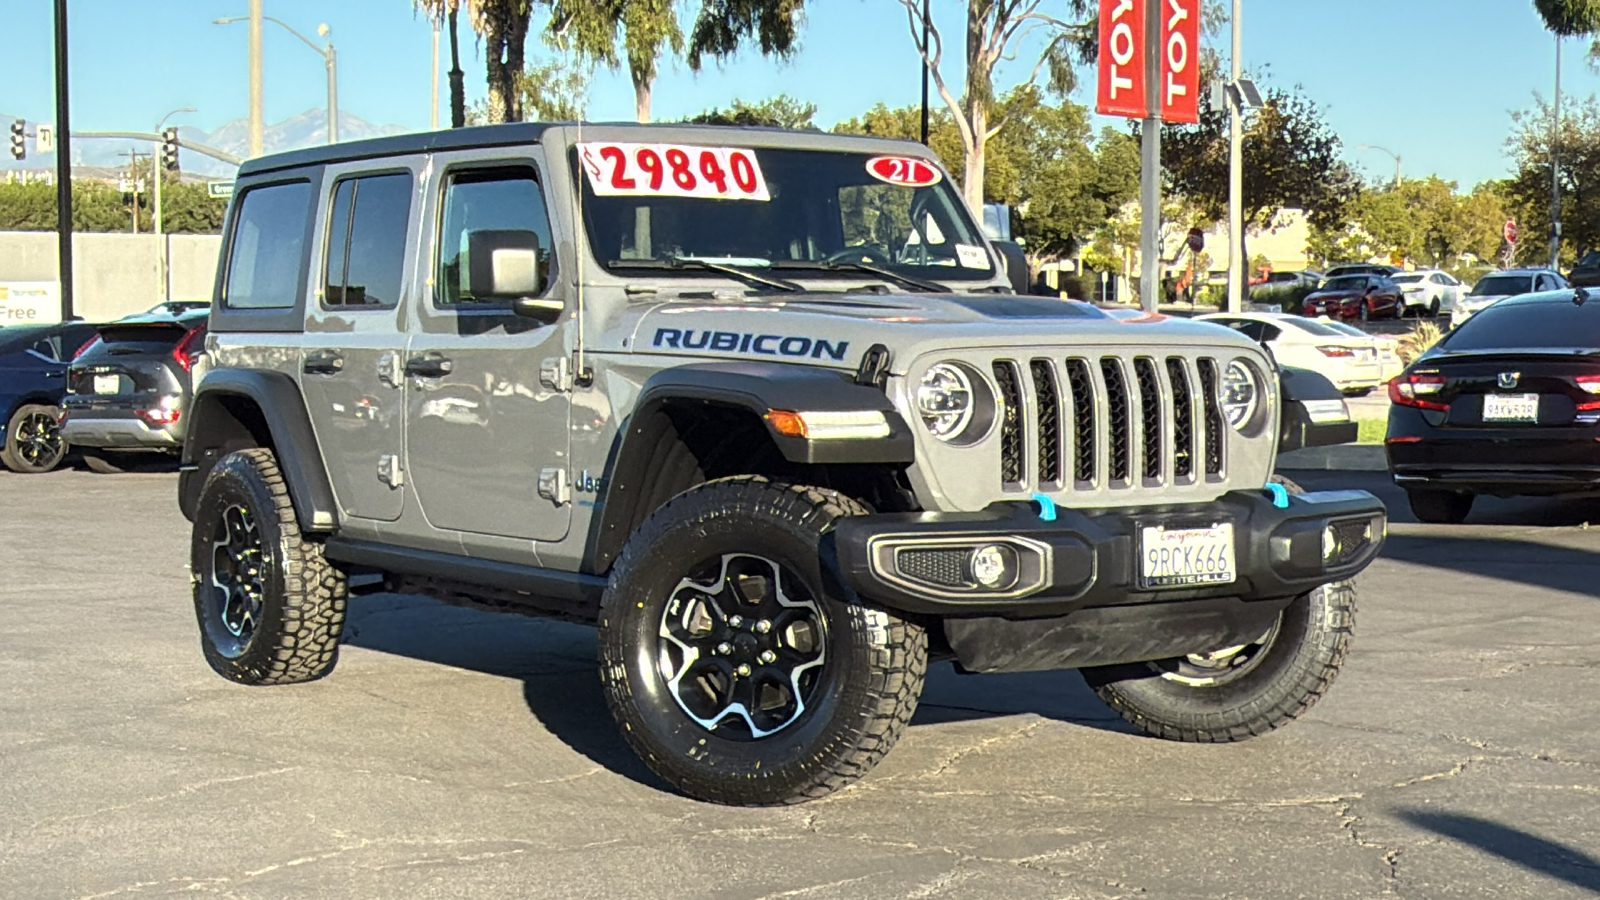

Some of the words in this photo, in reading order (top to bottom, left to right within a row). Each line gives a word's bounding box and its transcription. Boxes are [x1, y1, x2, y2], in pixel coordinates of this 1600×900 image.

[584, 146, 758, 194] $29840
[888, 159, 917, 182] 21
[653, 327, 850, 361] RUBICON
[1149, 544, 1228, 577] 9RCK666
